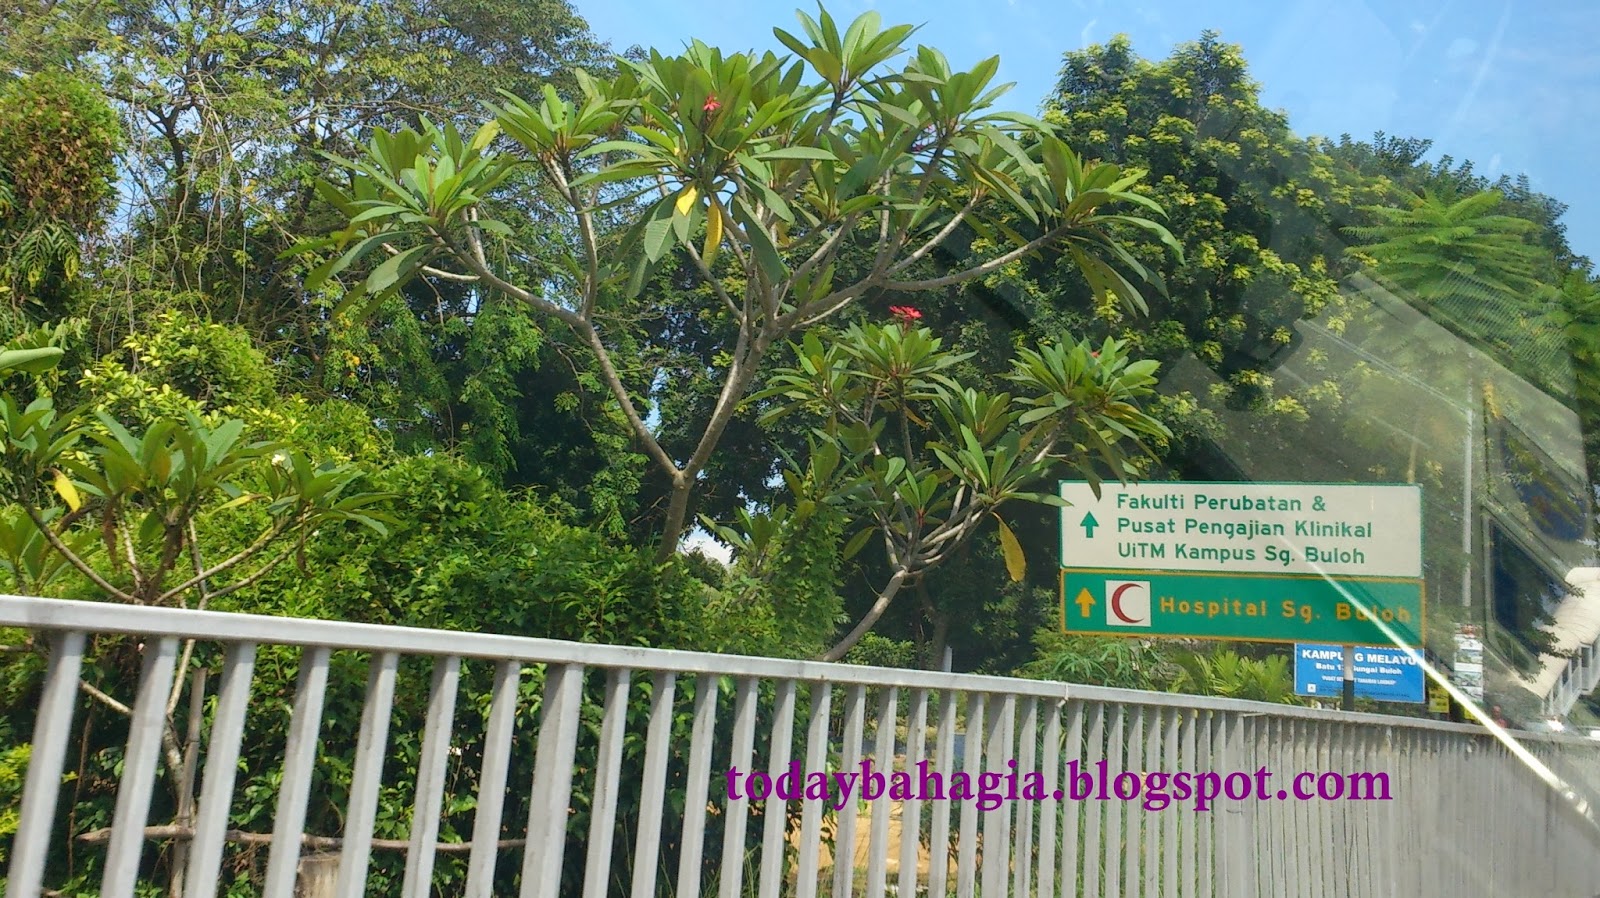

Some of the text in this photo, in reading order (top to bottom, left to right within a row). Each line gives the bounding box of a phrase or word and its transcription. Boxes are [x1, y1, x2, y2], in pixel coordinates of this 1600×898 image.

[1116, 493, 1327, 512] Fakulti Perubatan &
[1117, 518, 1372, 540] Pusat Pengajian Klinikal
[1118, 542, 1365, 566] UiTM Kampus Sg. Buloh
[1160, 597, 1267, 617] Hospital
[1282, 601, 1321, 622] Sg.
[1302, 649, 1417, 666] KAMPUG MELAYU
[1316, 662, 1335, 670] Batu
[1379, 667, 1402, 675] Buloh
